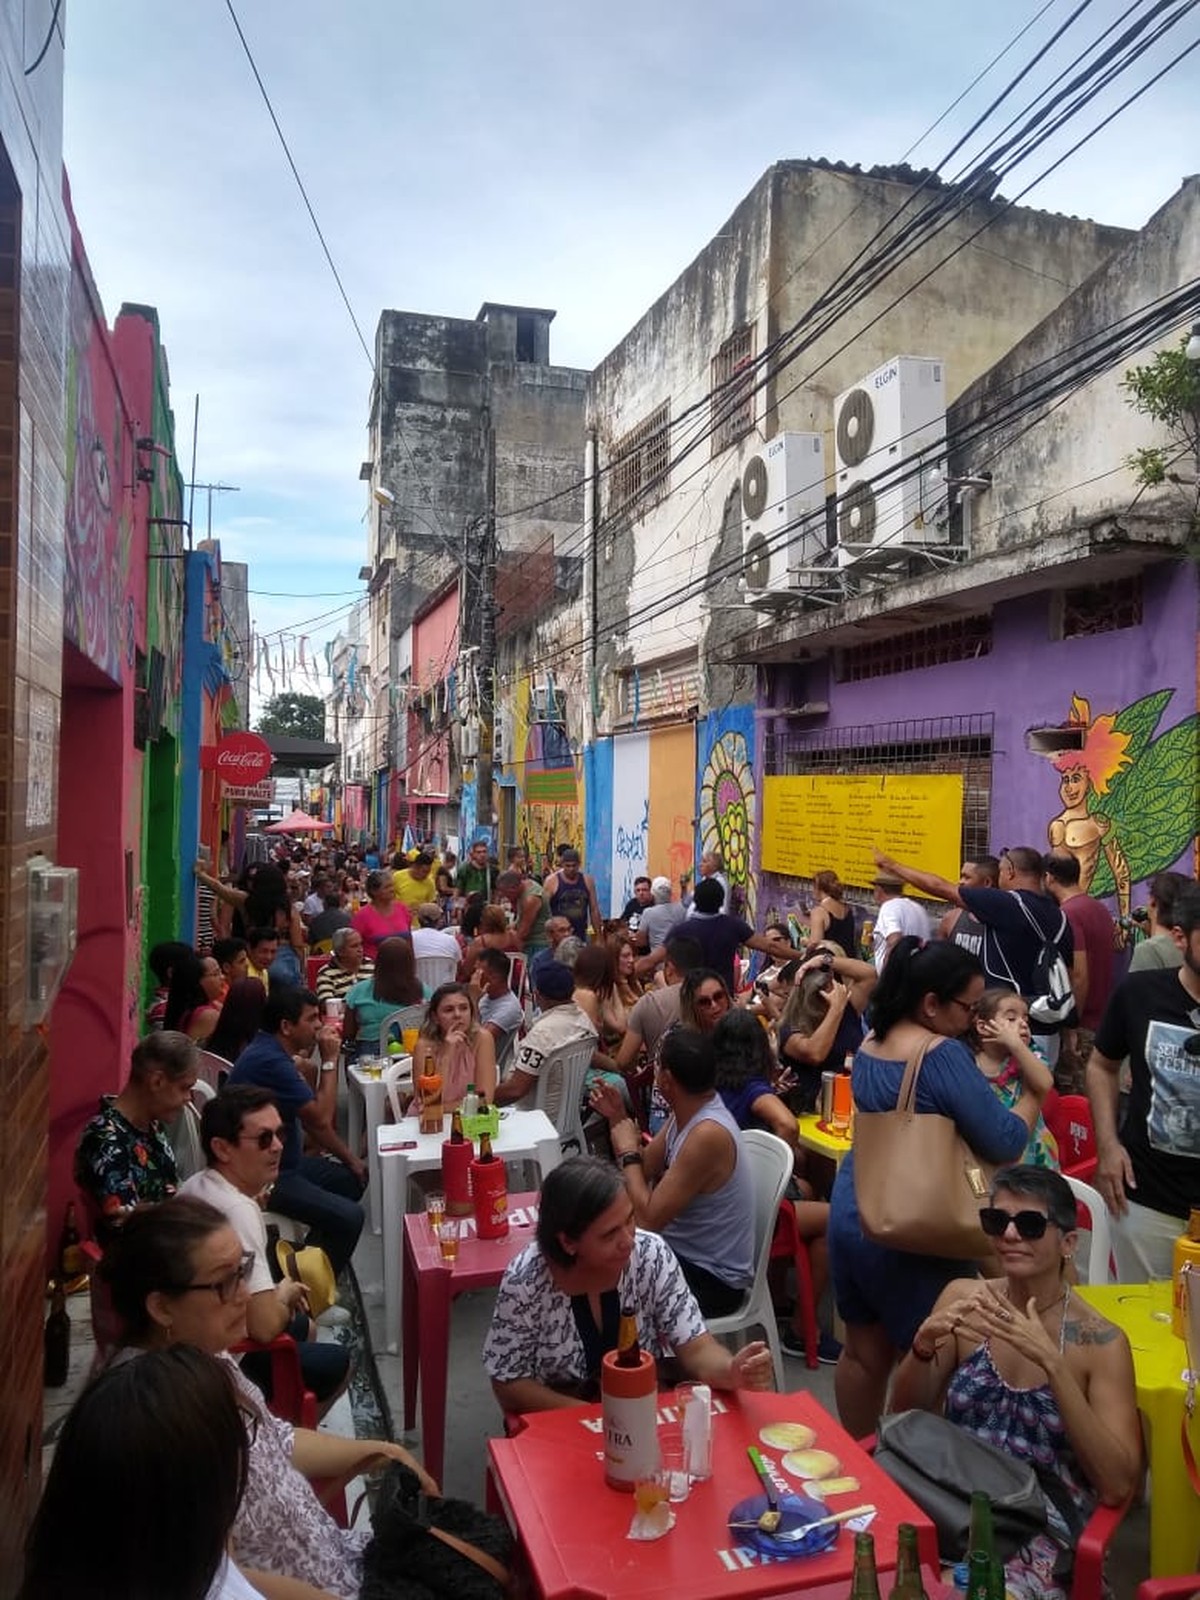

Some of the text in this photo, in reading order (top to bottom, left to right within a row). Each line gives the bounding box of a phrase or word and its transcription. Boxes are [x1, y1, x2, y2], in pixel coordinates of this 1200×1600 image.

[874, 365, 898, 389] ELGIN
[768, 442, 784, 458] ELGIN
[520, 1047, 544, 1069] 93
